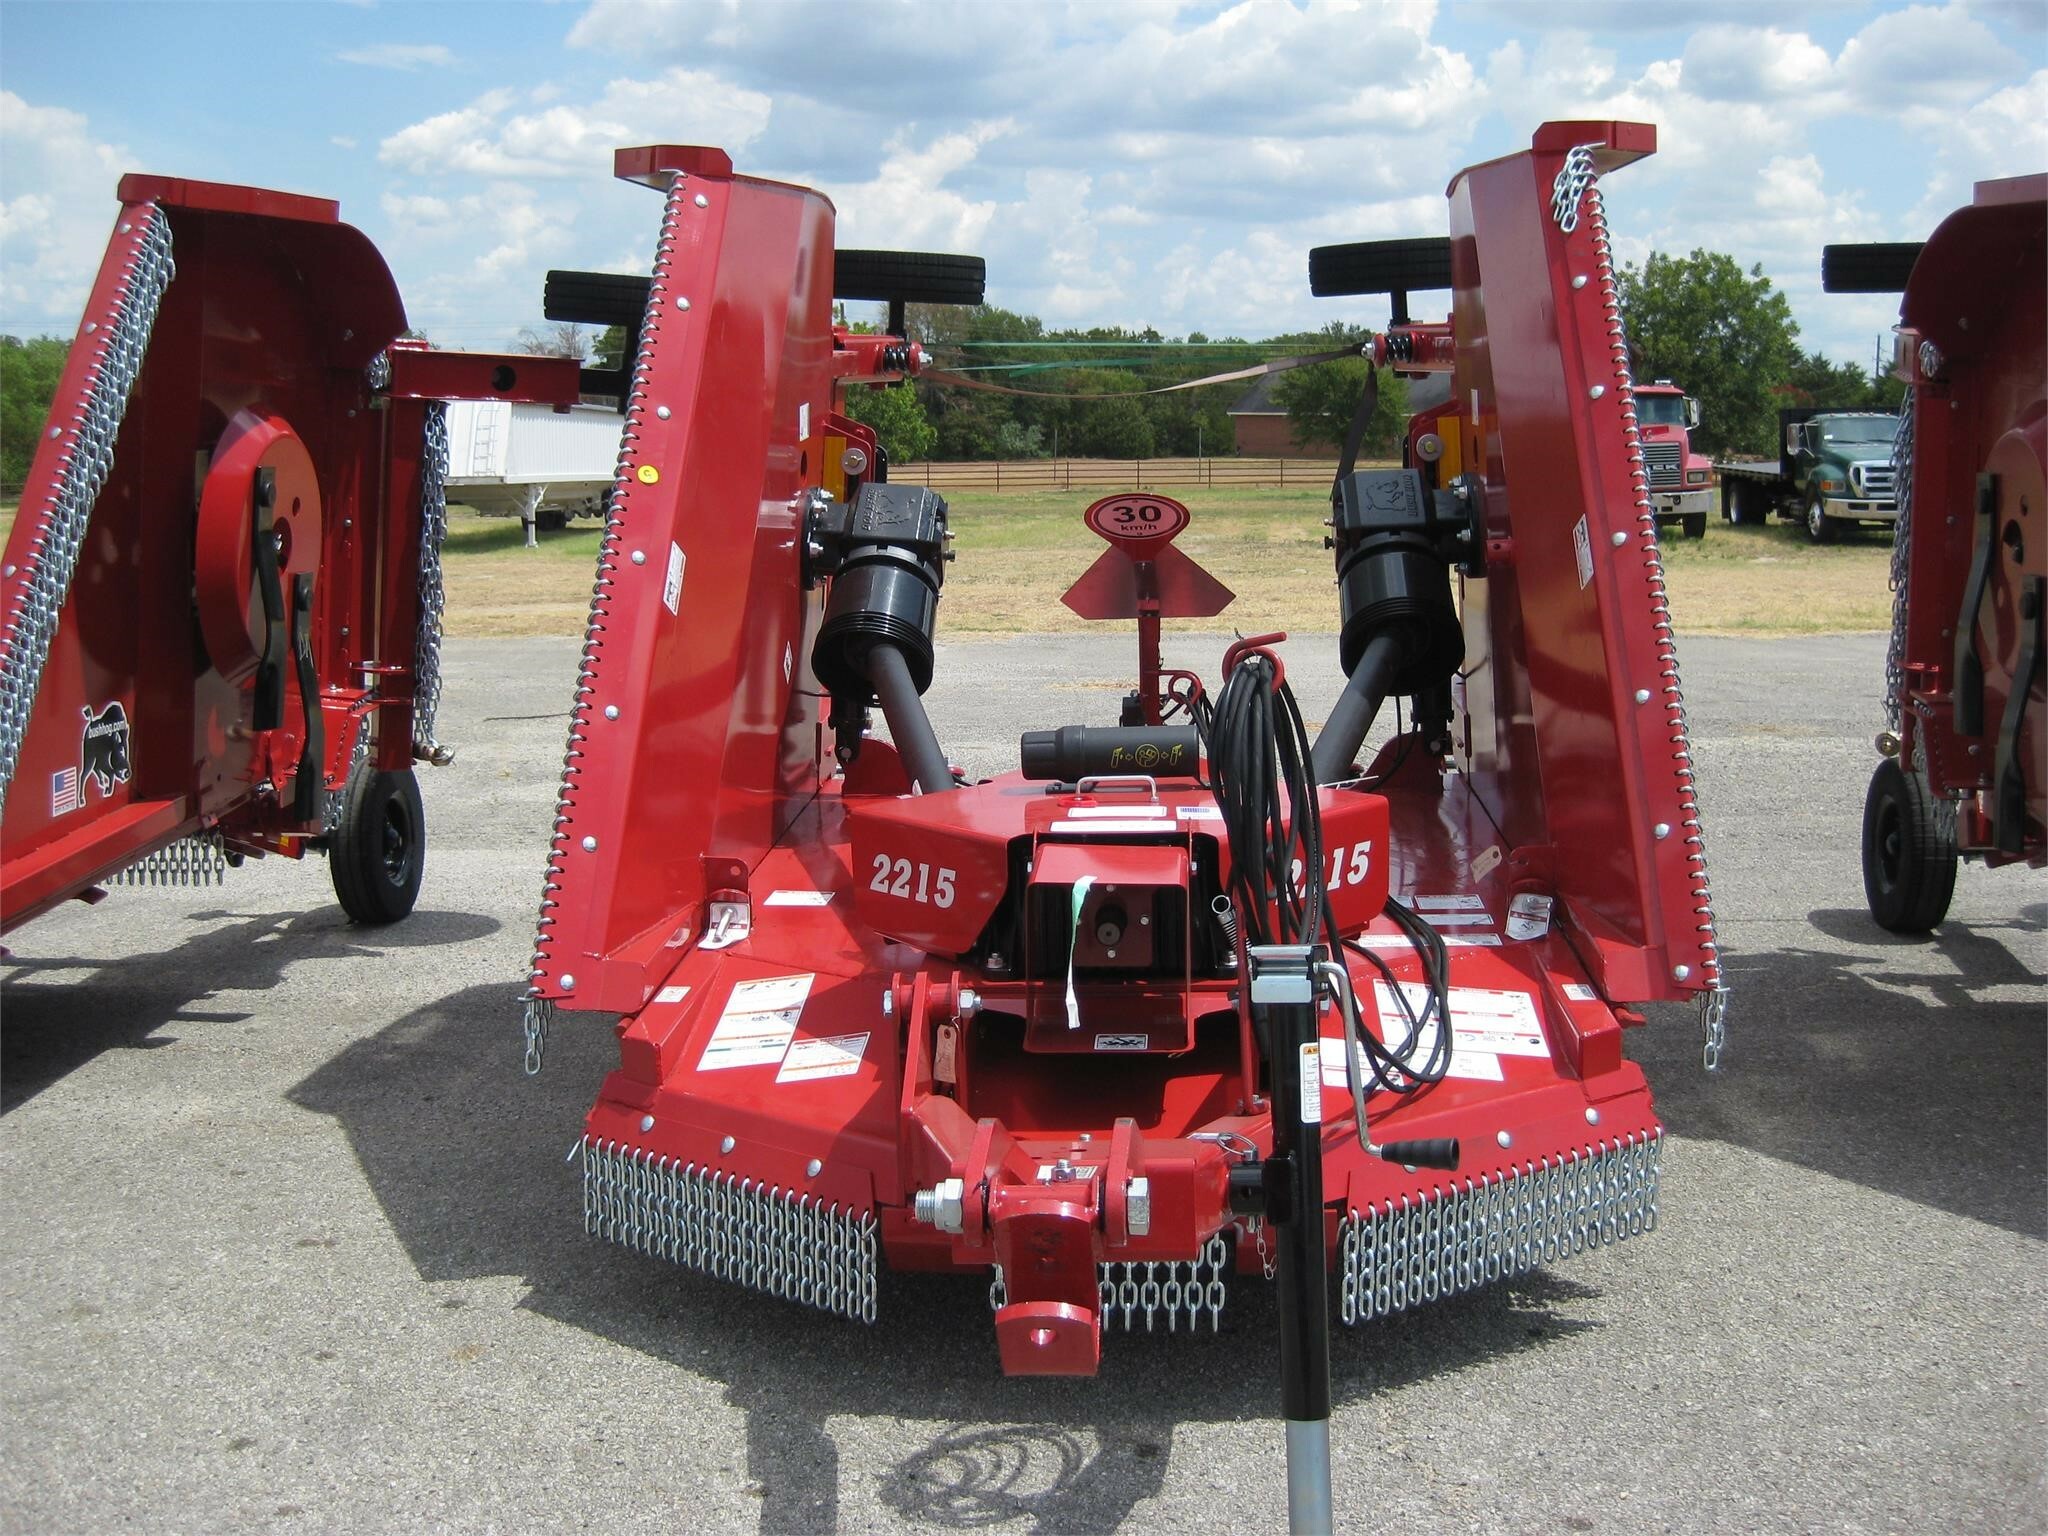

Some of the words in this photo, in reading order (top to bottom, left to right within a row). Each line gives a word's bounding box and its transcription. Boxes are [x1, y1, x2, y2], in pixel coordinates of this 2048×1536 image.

[1112, 505, 1162, 523] 30
[1120, 524, 1157, 532] km/h
[88, 720, 126, 739] bushhog.com
[869, 853, 957, 909] 2215
